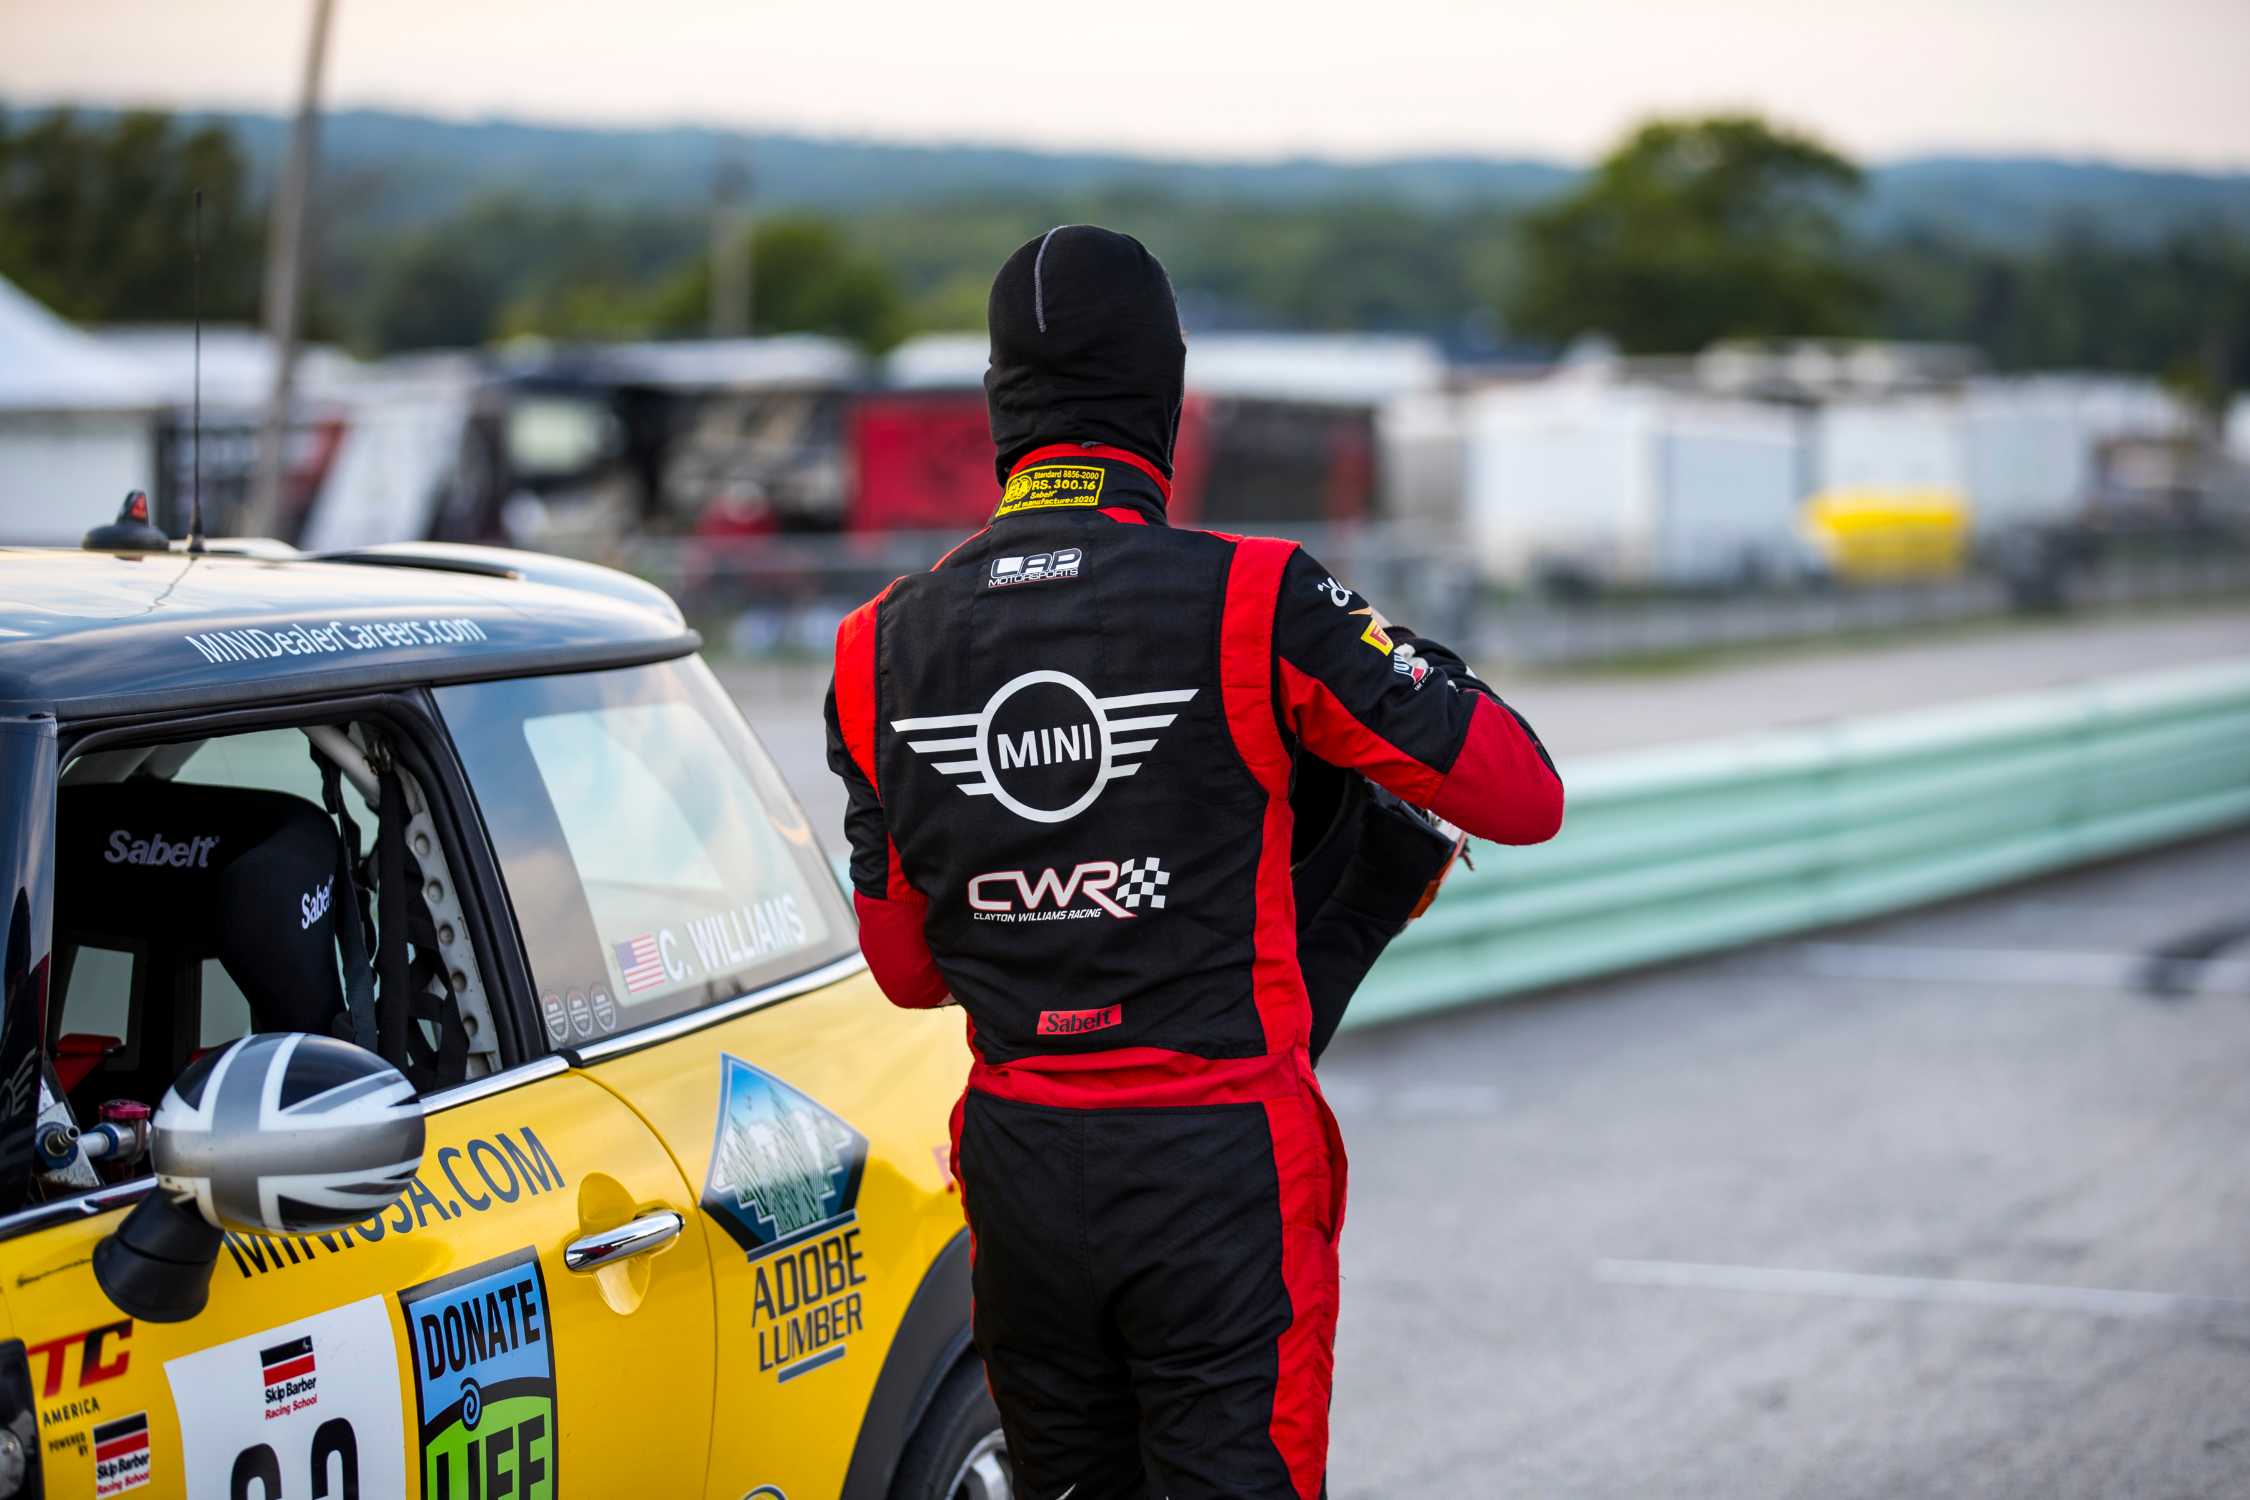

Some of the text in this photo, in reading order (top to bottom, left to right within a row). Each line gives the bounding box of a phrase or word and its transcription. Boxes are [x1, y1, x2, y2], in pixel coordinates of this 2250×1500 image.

[1032, 479, 1096, 490] RS. 300.16
[1063, 471, 1099, 480] 8856-2000
[988, 568, 1079, 588] MOTORSPORTS
[991, 548, 1082, 578] LAP
[185, 617, 487, 663] MINIDealerCareers.com
[997, 724, 1092, 769] MINI
[104, 830, 216, 868] Sabelt
[968, 861, 1137, 919] CWR
[974, 908, 1102, 922] CLAYTON WILLIAMS RACING
[686, 894, 806, 972] WILLIAMS
[1046, 1009, 1111, 1032] Sabelt
[751, 1228, 867, 1328] ADOBE
[420, 1279, 541, 1381] DONATE
[759, 1292, 863, 1372] LUMBER
[265, 1377, 317, 1404] Skip Barber
[43, 1396, 100, 1427] AMERICA
[265, 1394, 318, 1420] Racing School
[96, 1452, 150, 1480] Skip Barber
